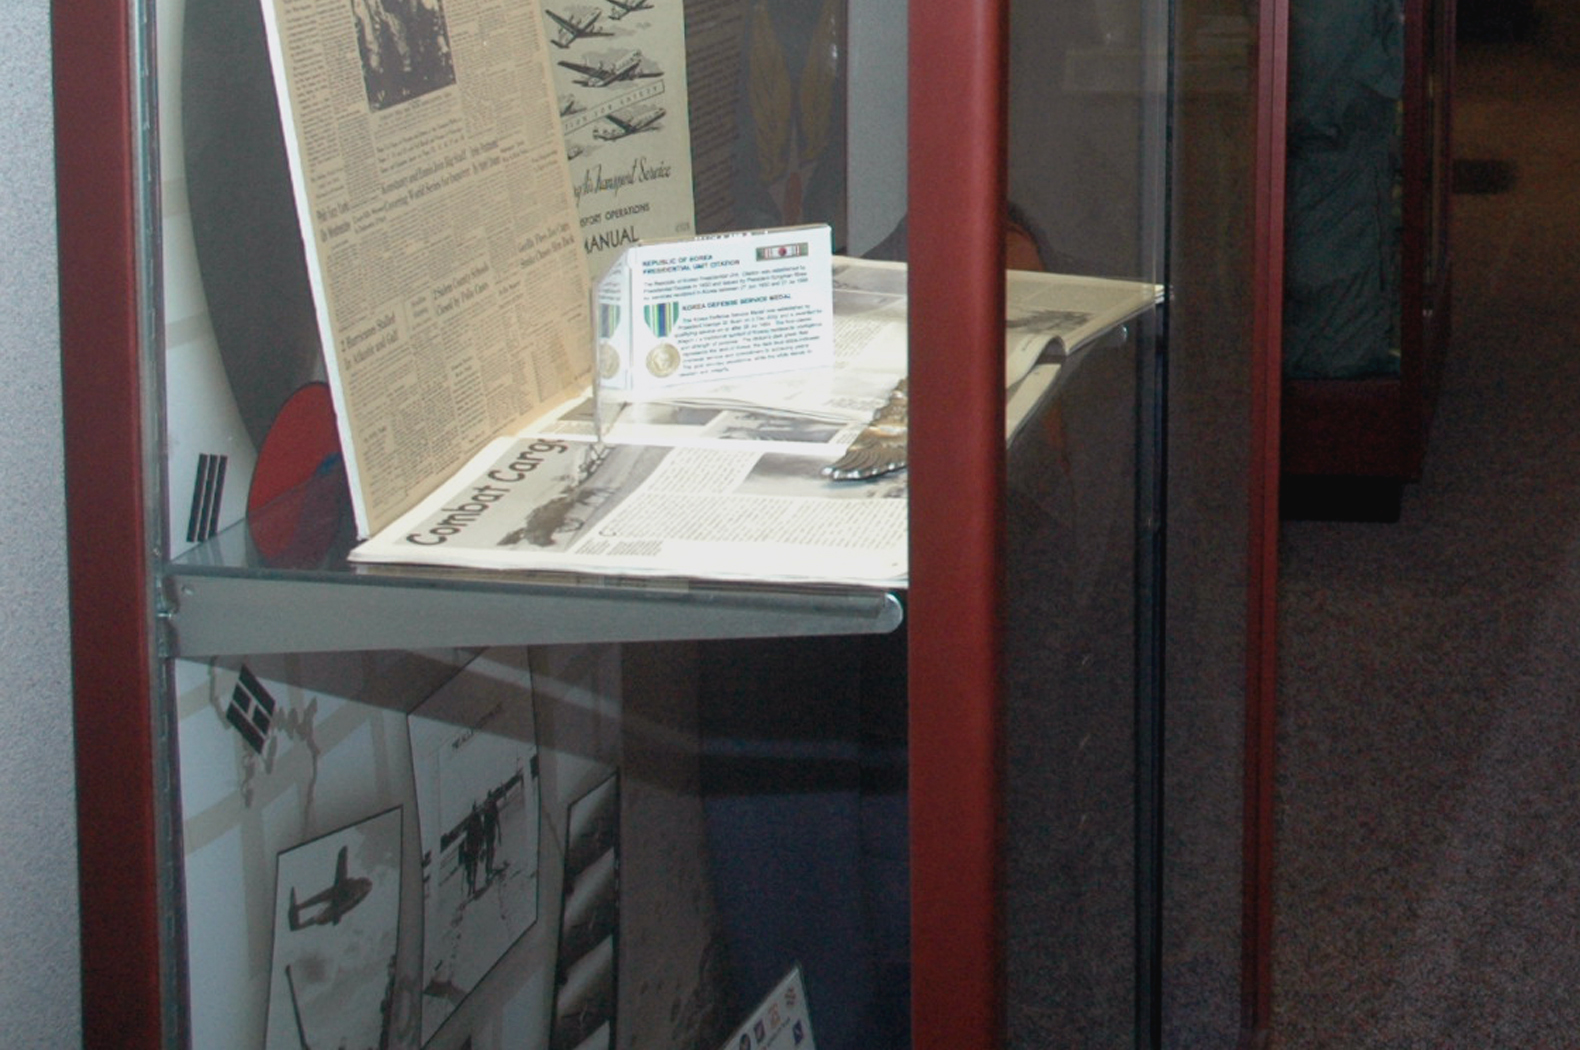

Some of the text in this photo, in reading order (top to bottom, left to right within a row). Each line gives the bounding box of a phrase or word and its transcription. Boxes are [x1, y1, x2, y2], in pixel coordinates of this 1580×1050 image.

[592, 158, 637, 197] Transport
[639, 156, 671, 183] Service
[605, 202, 650, 221] OPERATIONS
[643, 257, 676, 266] REPUBLIC
[690, 254, 713, 262] KOREA
[643, 259, 740, 274] PRESIDENTIAL UNIT CITATION
[682, 293, 791, 311] KOREA DEFENSE SERVICE MEDAL
[406, 438, 569, 546] Combat Carg
